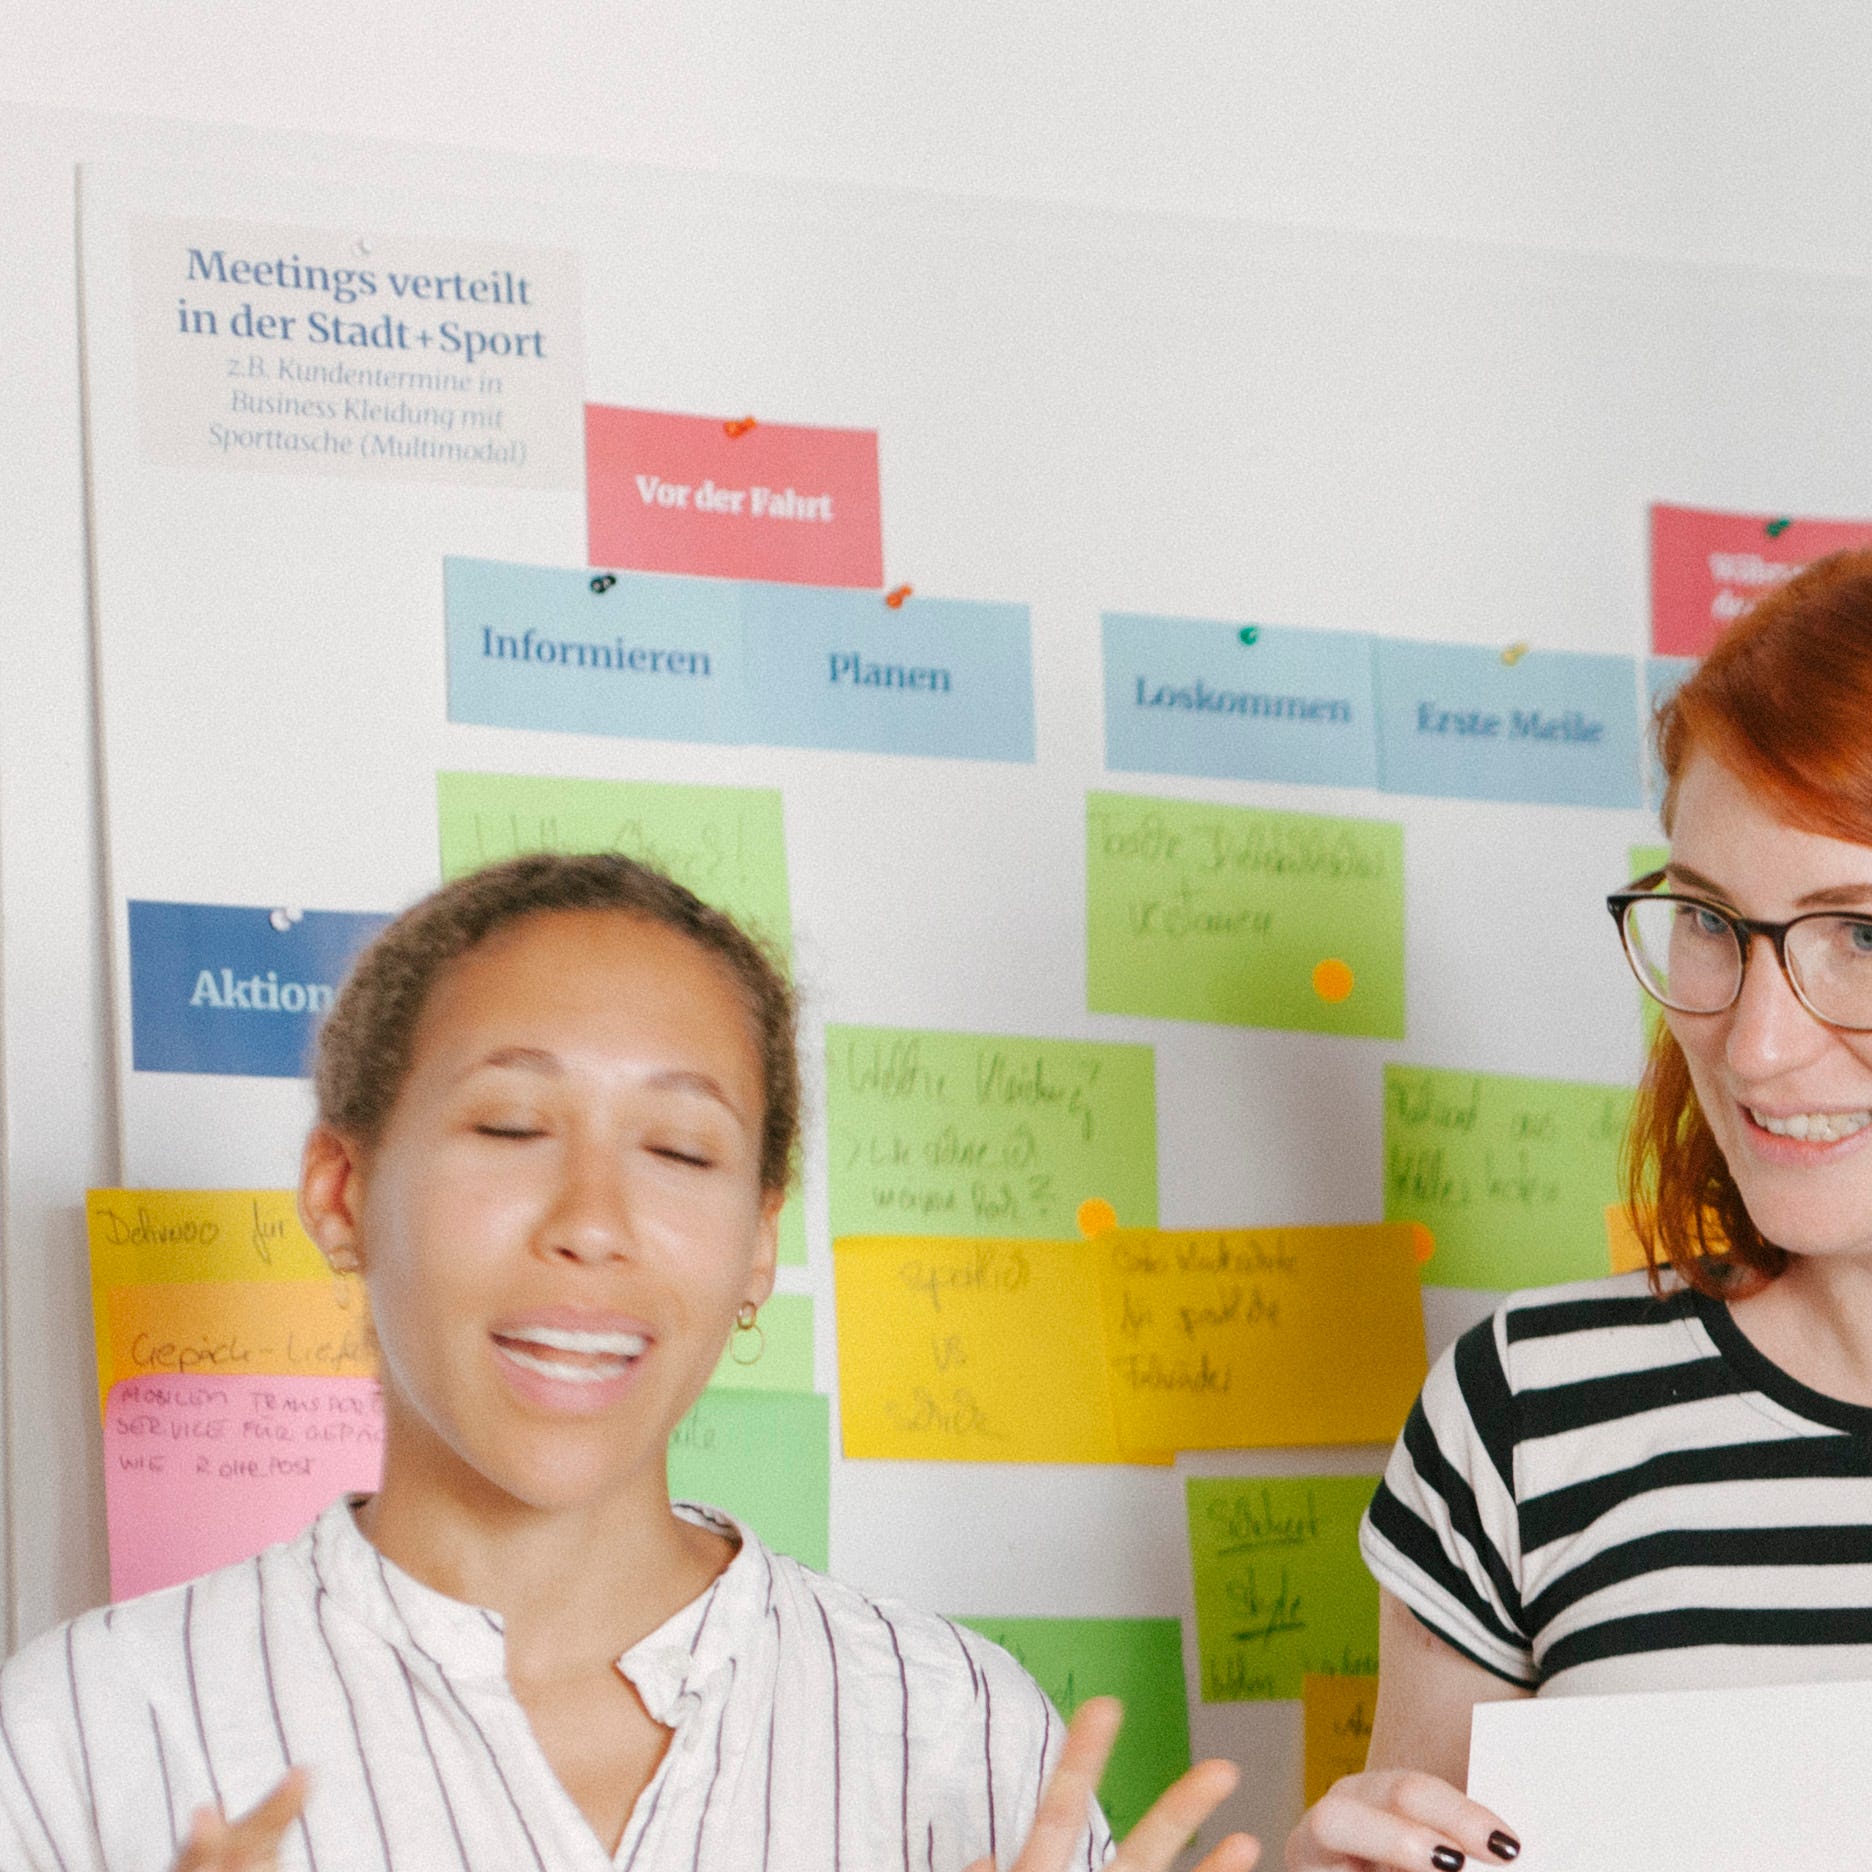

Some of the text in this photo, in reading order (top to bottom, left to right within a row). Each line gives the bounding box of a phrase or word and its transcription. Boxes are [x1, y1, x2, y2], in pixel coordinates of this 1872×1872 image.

[186, 248, 531, 305] Meetings verteilt
[178, 299, 217, 334] in
[230, 303, 295, 340] der
[226, 355, 502, 395] z.B. Kundentermine in
[231, 391, 504, 431] Business Kleidung mit
[208, 423, 527, 465] Sporttasche (Multimodal)
[635, 474, 833, 522] Vor der Fahrt
[481, 625, 711, 676] Informieren
[828, 651, 951, 693] Planen
[1135, 676, 1352, 724] Loskommen
[1416, 702, 1604, 744] Erste Meile
